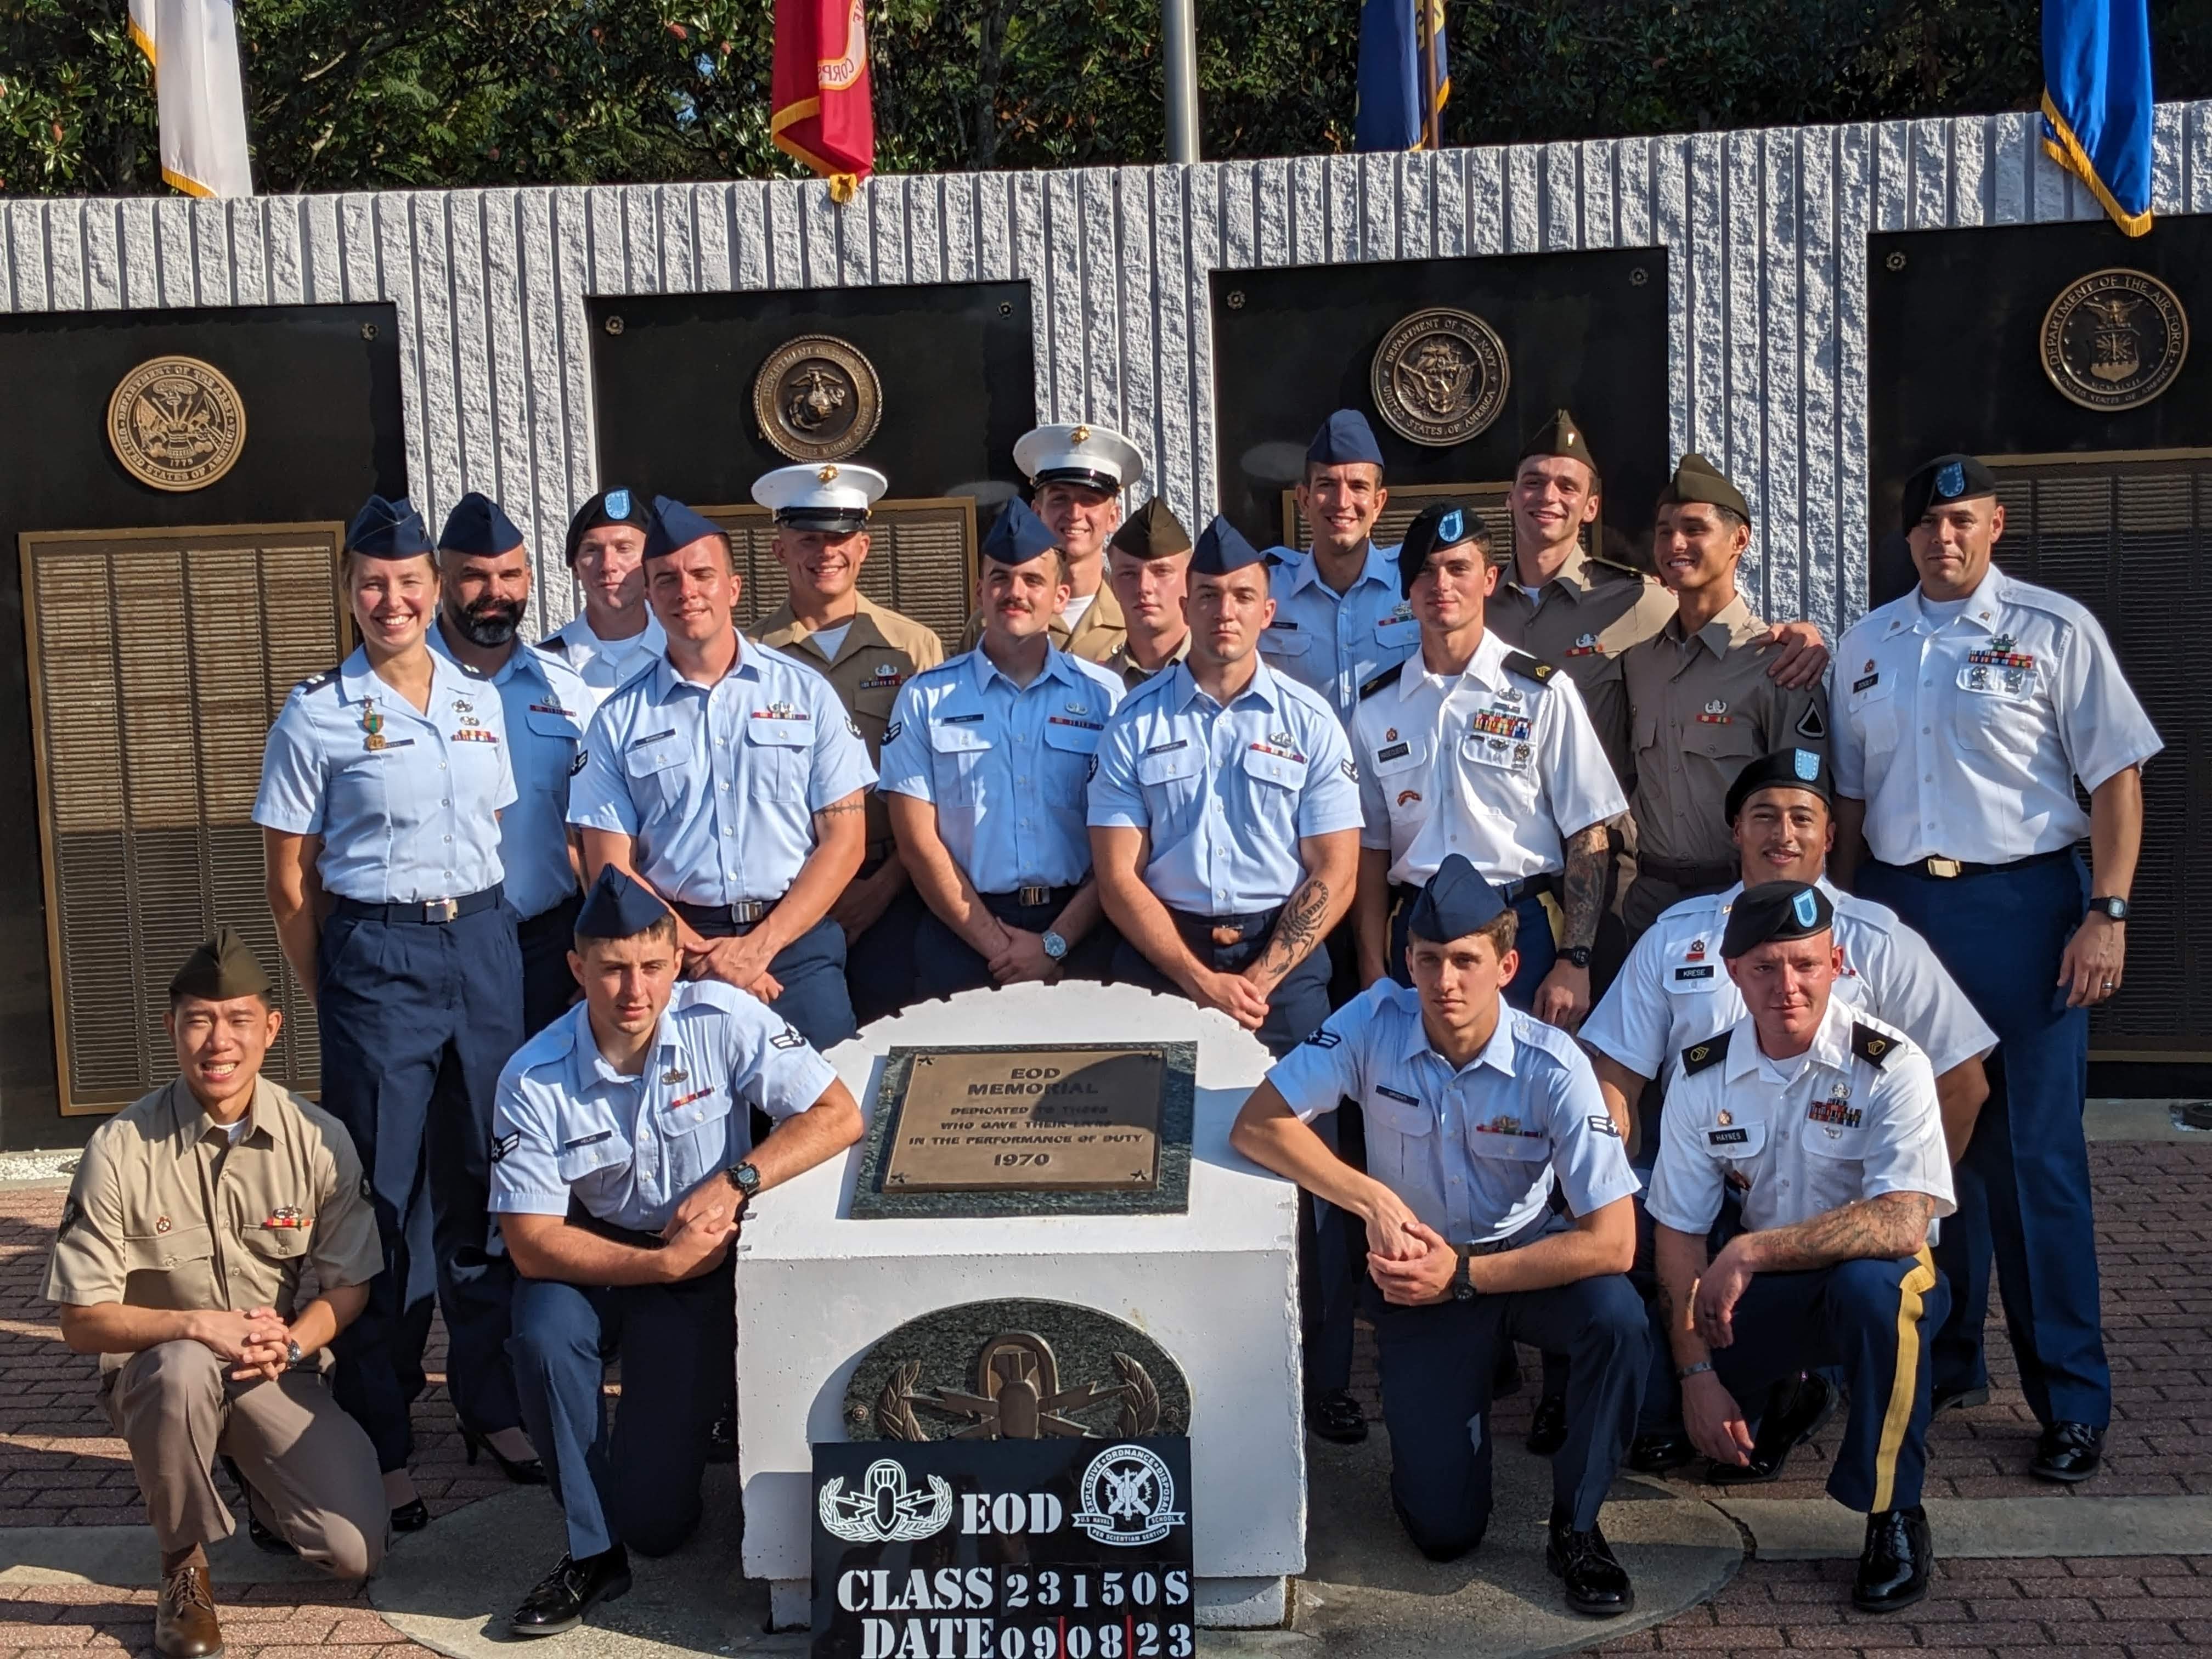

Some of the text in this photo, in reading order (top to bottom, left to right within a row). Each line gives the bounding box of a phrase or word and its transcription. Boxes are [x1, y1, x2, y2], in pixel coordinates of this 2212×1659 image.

[2047, 275, 2182, 366] DEPARTMENT OF THE AIR FORCE
[1385, 319, 1497, 368] DEPARTMENT OF THE NAVY
[763, 346, 813, 397] DEPARTMENT
[2060, 365, 2171, 404] UNITED STATES OF AMERICA
[119, 366, 235, 419] DEPARTMENT OF THE ARMY
[1383, 386, 1496, 435] UNITED STATES OF AMERICA
[119, 424, 236, 481] UNITED STATES OF AMERICA
[967, 1082, 1099, 1096] MEMORIAL
[1011, 1067, 1061, 1080] EOD
[940, 1121, 975, 1130] WHO
[980, 1121, 1018, 1130] GAVE
[1025, 1120, 1066, 1129] THEIR
[950, 1107, 1029, 1115] DEDICATED
[908, 1133, 1143, 1146] IN THE PERFORMANCE OF DUTY
[1715, 1132, 1742, 1142] HAYNES
[994, 1153, 1051, 1167] 1970
[1085, 1449, 1170, 1513] EXPLOSIVE ORDNANCE DISPOSAL
[960, 1493, 1063, 1534] EOD
[1092, 1517, 1110, 1525] NAVAL
[1092, 1528, 1104, 1538] PER
[1151, 1515, 1175, 1524] SCHOOL
[837, 1567, 994, 1612] CLASS
[860, 1618, 994, 1659] DATE
